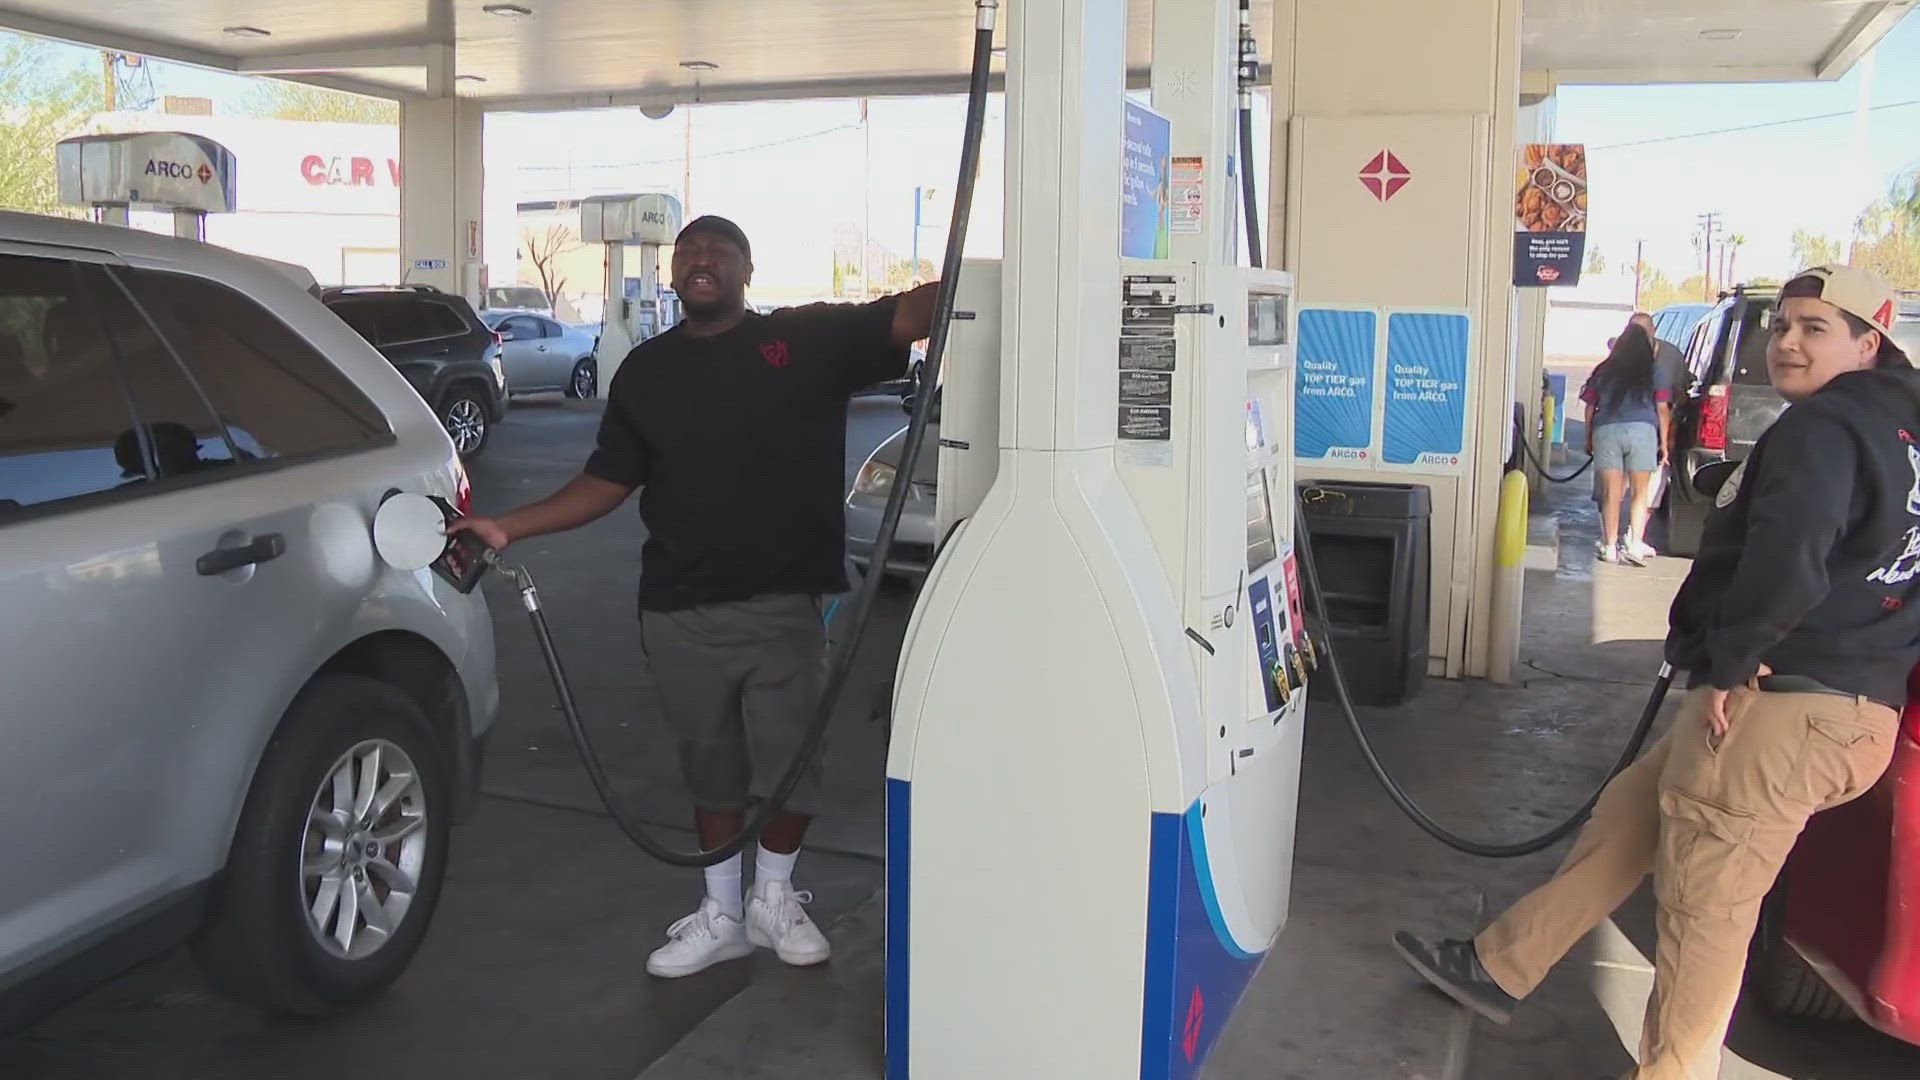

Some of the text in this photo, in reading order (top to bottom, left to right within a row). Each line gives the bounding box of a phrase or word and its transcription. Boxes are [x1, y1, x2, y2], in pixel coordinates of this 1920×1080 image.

[145, 159, 193, 179] ARCO
[301, 155, 374, 186] CAR
[642, 211, 665, 224] ARCO
[1304, 361, 1338, 372] Quality
[1394, 364, 1428, 376] Quality
[1304, 373, 1366, 386] TOP TIER gas
[1394, 378, 1458, 391] TOP TIER gas
[1303, 386, 1356, 398] from ARCO.
[1393, 391, 1447, 402] from ARCO.
[1331, 450, 1358, 459] ARCO
[1422, 455, 1448, 465] ARCO
